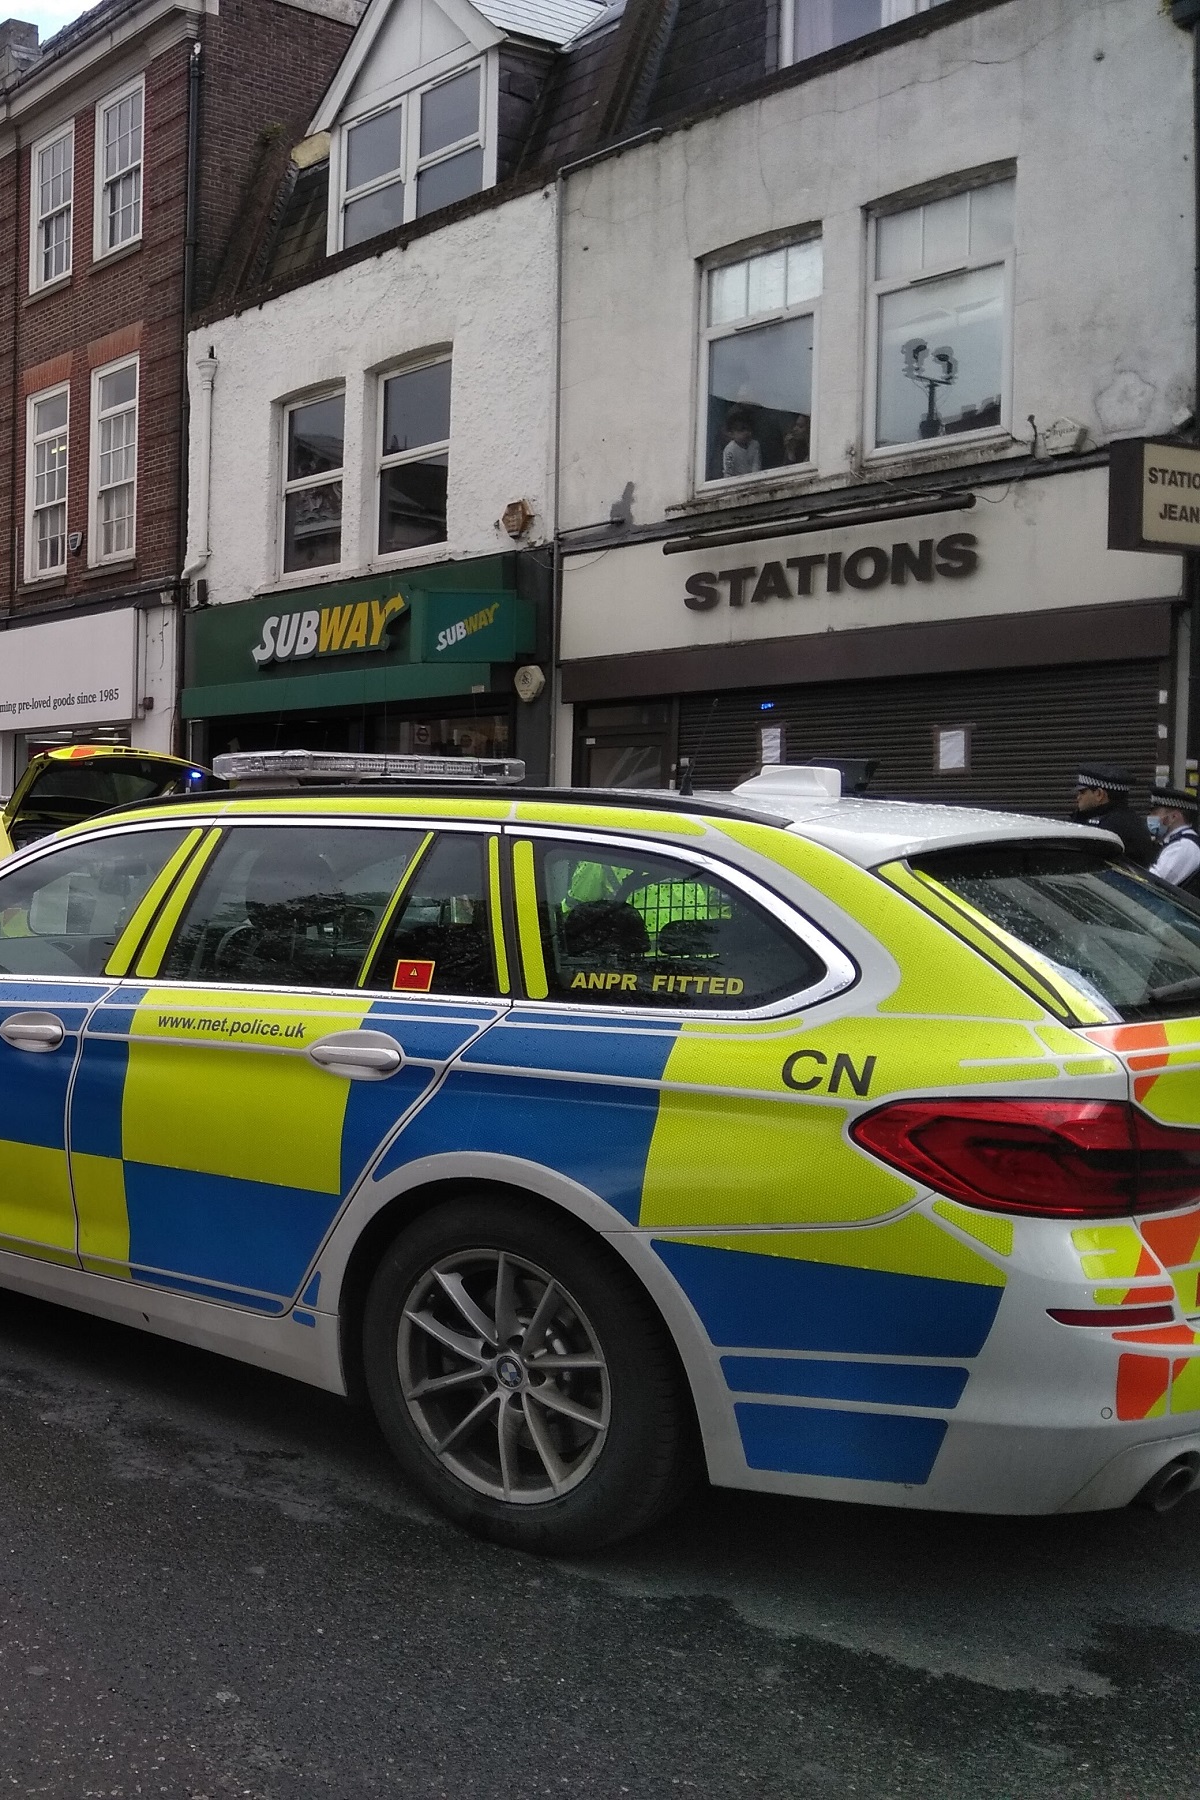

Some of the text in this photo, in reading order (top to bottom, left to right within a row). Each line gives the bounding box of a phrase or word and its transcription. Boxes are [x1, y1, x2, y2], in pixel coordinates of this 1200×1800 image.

[683, 532, 980, 613] STATIONS
[252, 592, 406, 664] SUBWAY
[436, 602, 499, 651] SUBWAY
[18, 696, 51, 714] pre-loved
[52, 693, 75, 711] goods
[76, 691, 97, 705] since
[99, 688, 120, 702] 1985
[570, 972, 744, 995] ANPR FITTED
[158, 1015, 307, 1039] www.met.police.uk
[781, 1049, 877, 1097] CN
